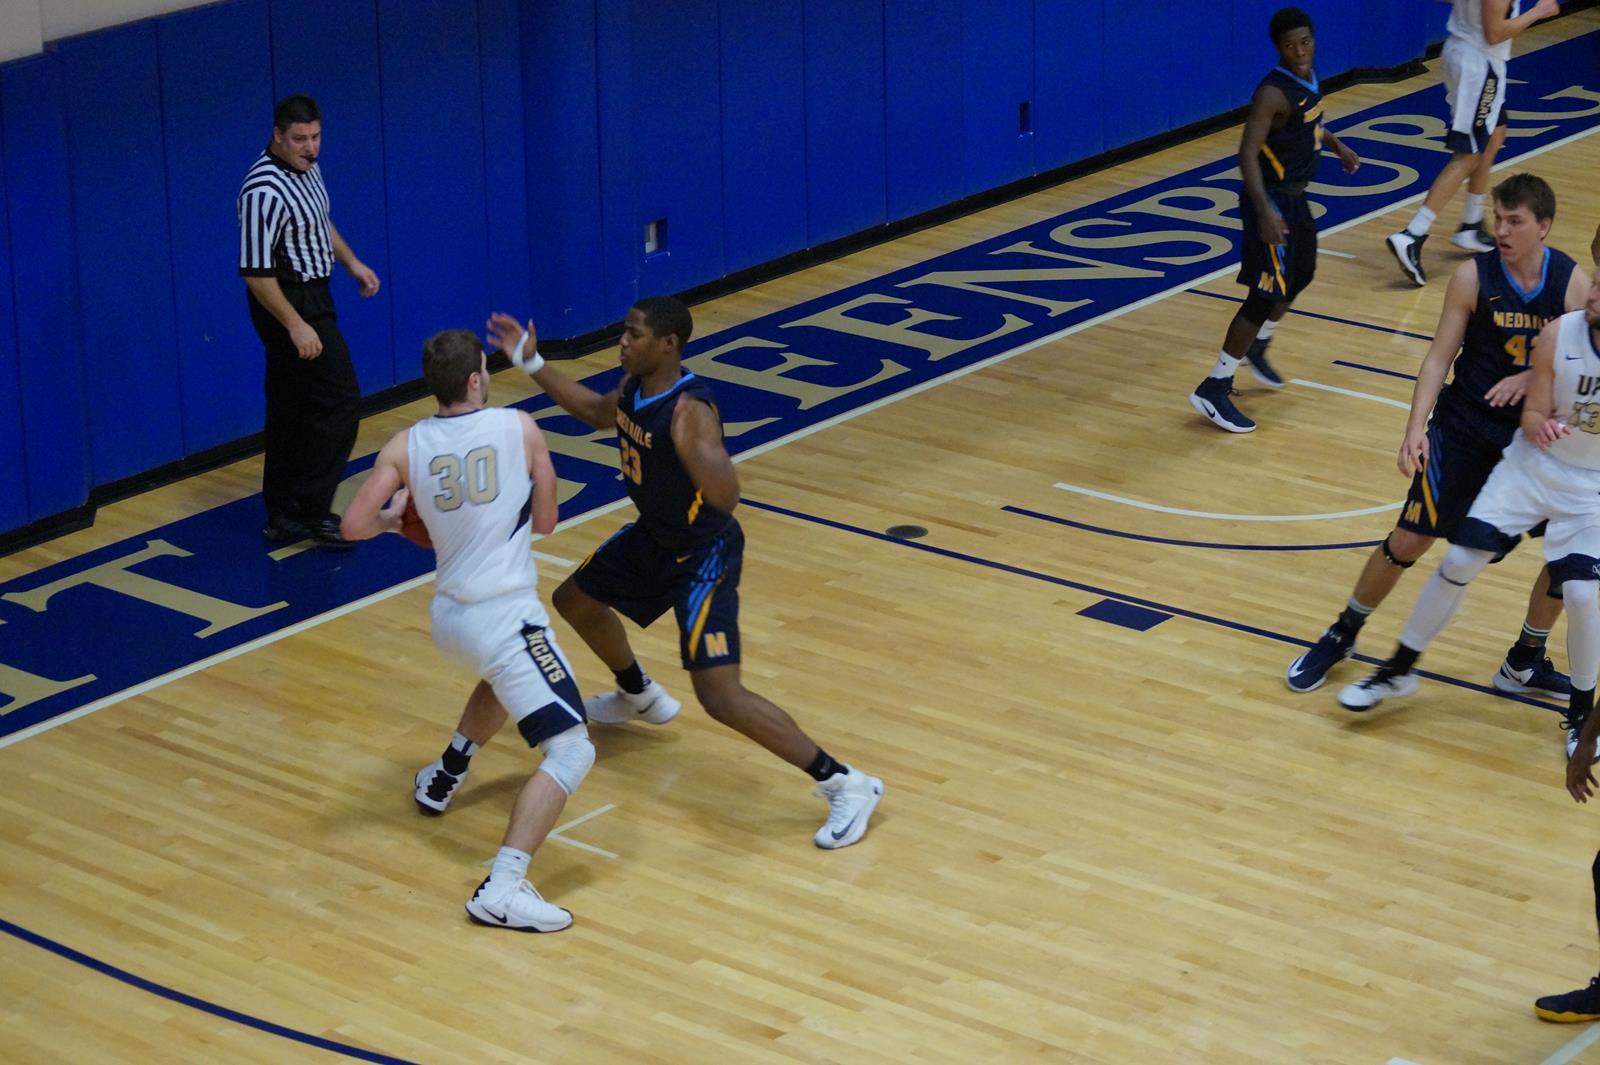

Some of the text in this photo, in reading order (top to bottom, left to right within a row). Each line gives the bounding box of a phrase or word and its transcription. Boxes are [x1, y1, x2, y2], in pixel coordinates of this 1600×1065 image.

[1258, 271, 1275, 293] M
[620, 437, 642, 486] 23
[428, 445, 501, 512] 30
[1404, 501, 1423, 525] M
[705, 632, 729, 658] M
